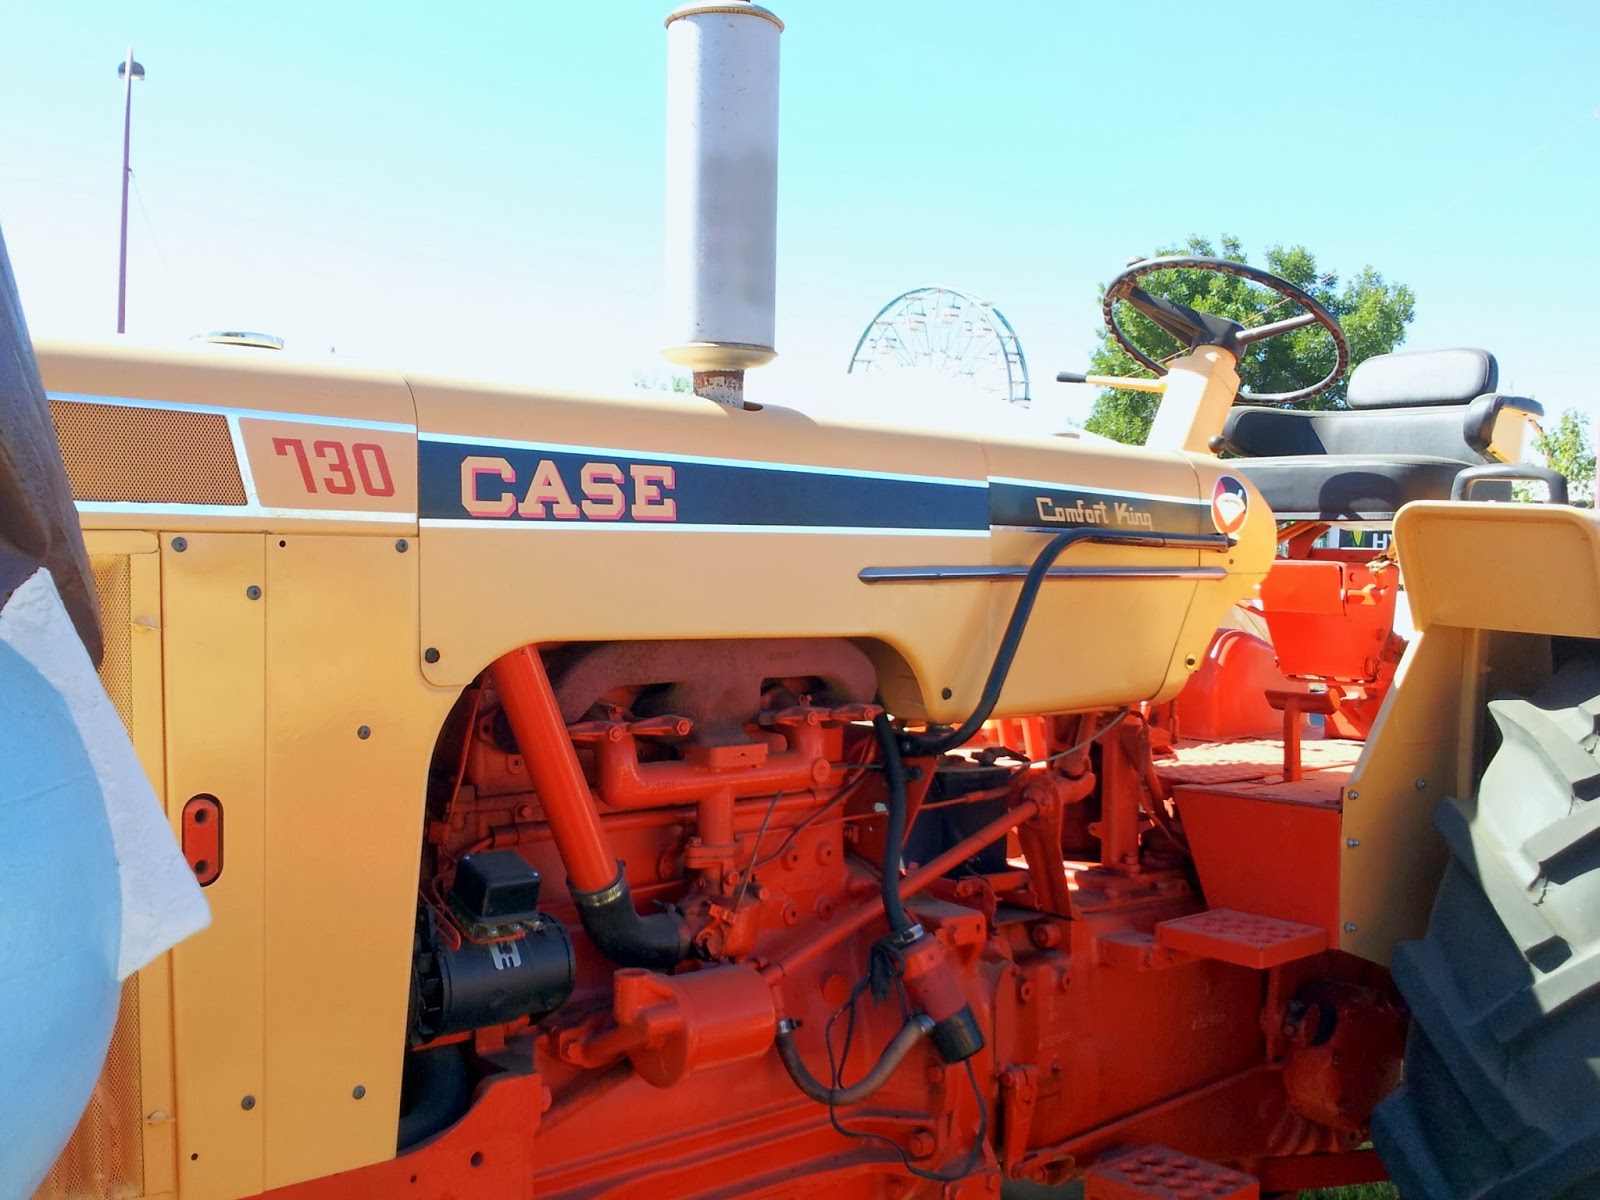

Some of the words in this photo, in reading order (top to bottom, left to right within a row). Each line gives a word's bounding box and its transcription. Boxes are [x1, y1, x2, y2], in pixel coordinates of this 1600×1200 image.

[272, 437, 395, 497] 730
[460, 455, 677, 521] CASE
[1035, 496, 1109, 524] Comfort
[1113, 502, 1154, 531] King
